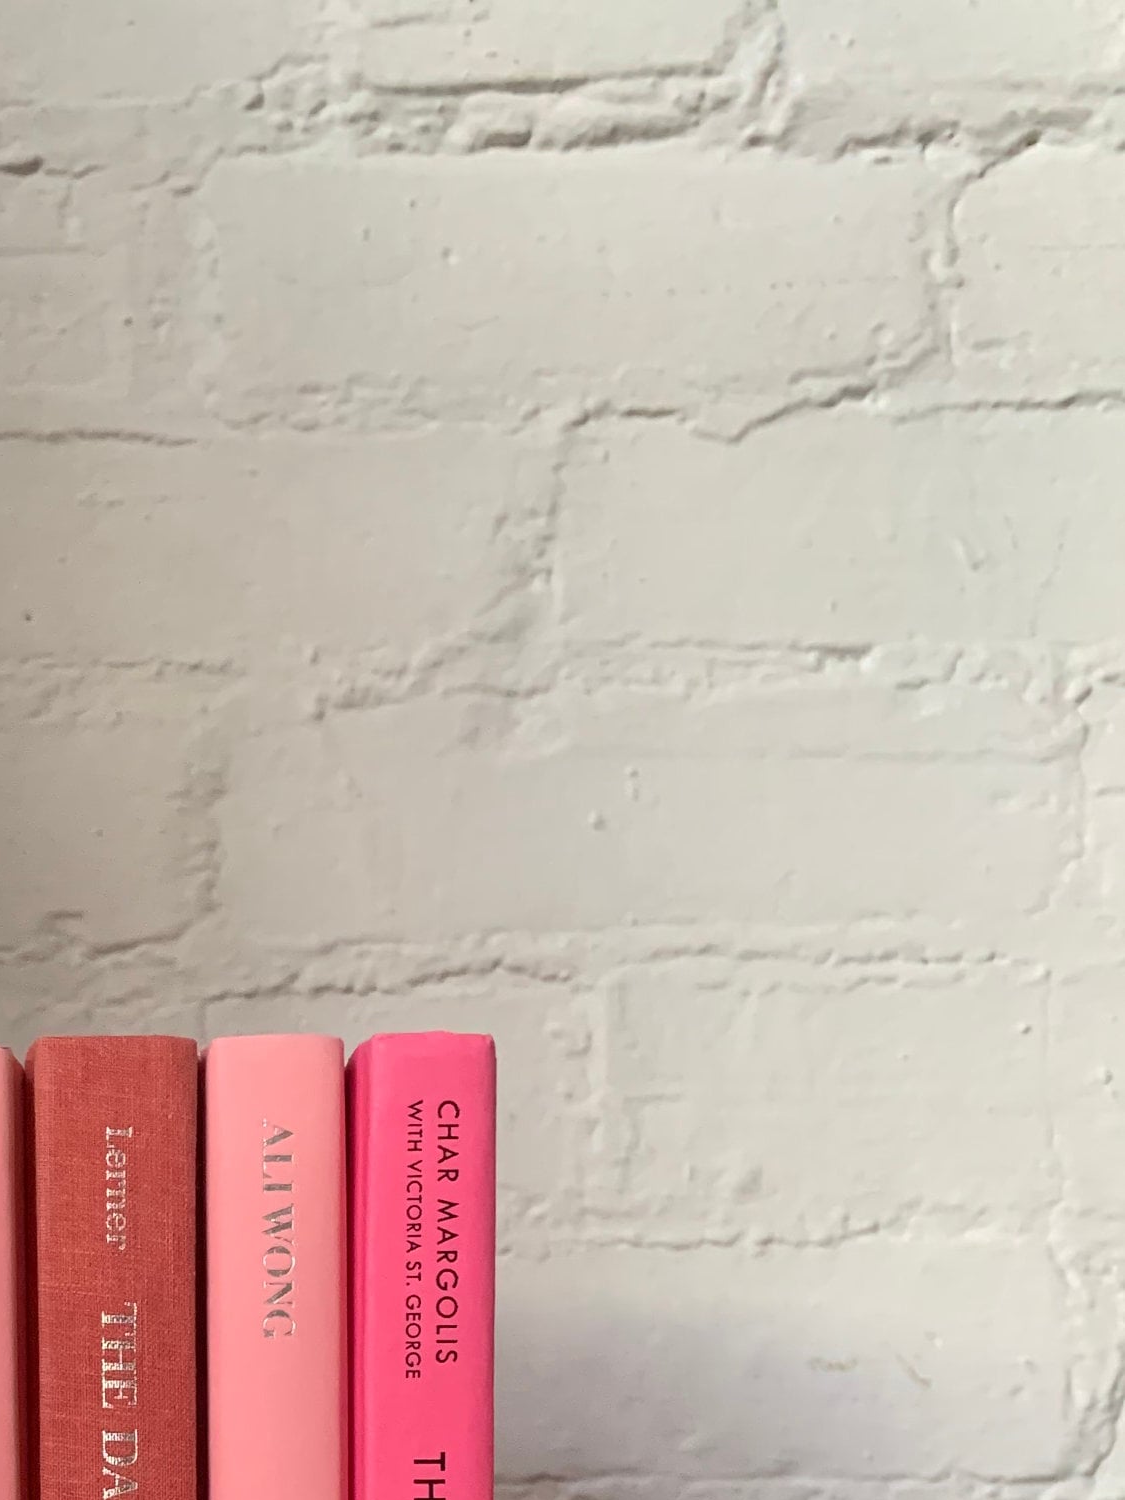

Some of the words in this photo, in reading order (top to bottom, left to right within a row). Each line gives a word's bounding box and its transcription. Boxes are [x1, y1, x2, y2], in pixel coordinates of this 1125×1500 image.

[262, 1118, 295, 1193] ALI
[407, 1100, 424, 1152] WITH
[436, 1100, 461, 1183] CHAR
[105, 1126, 133, 1251] Lerner
[406, 1160, 423, 1254] VICTORIA
[261, 1203, 297, 1339] WONG
[405, 1261, 422, 1287] ST.
[435, 1199, 460, 1364] MARGOLIS
[101, 1300, 138, 1409] THE
[405, 1294, 422, 1379] GEORGE
